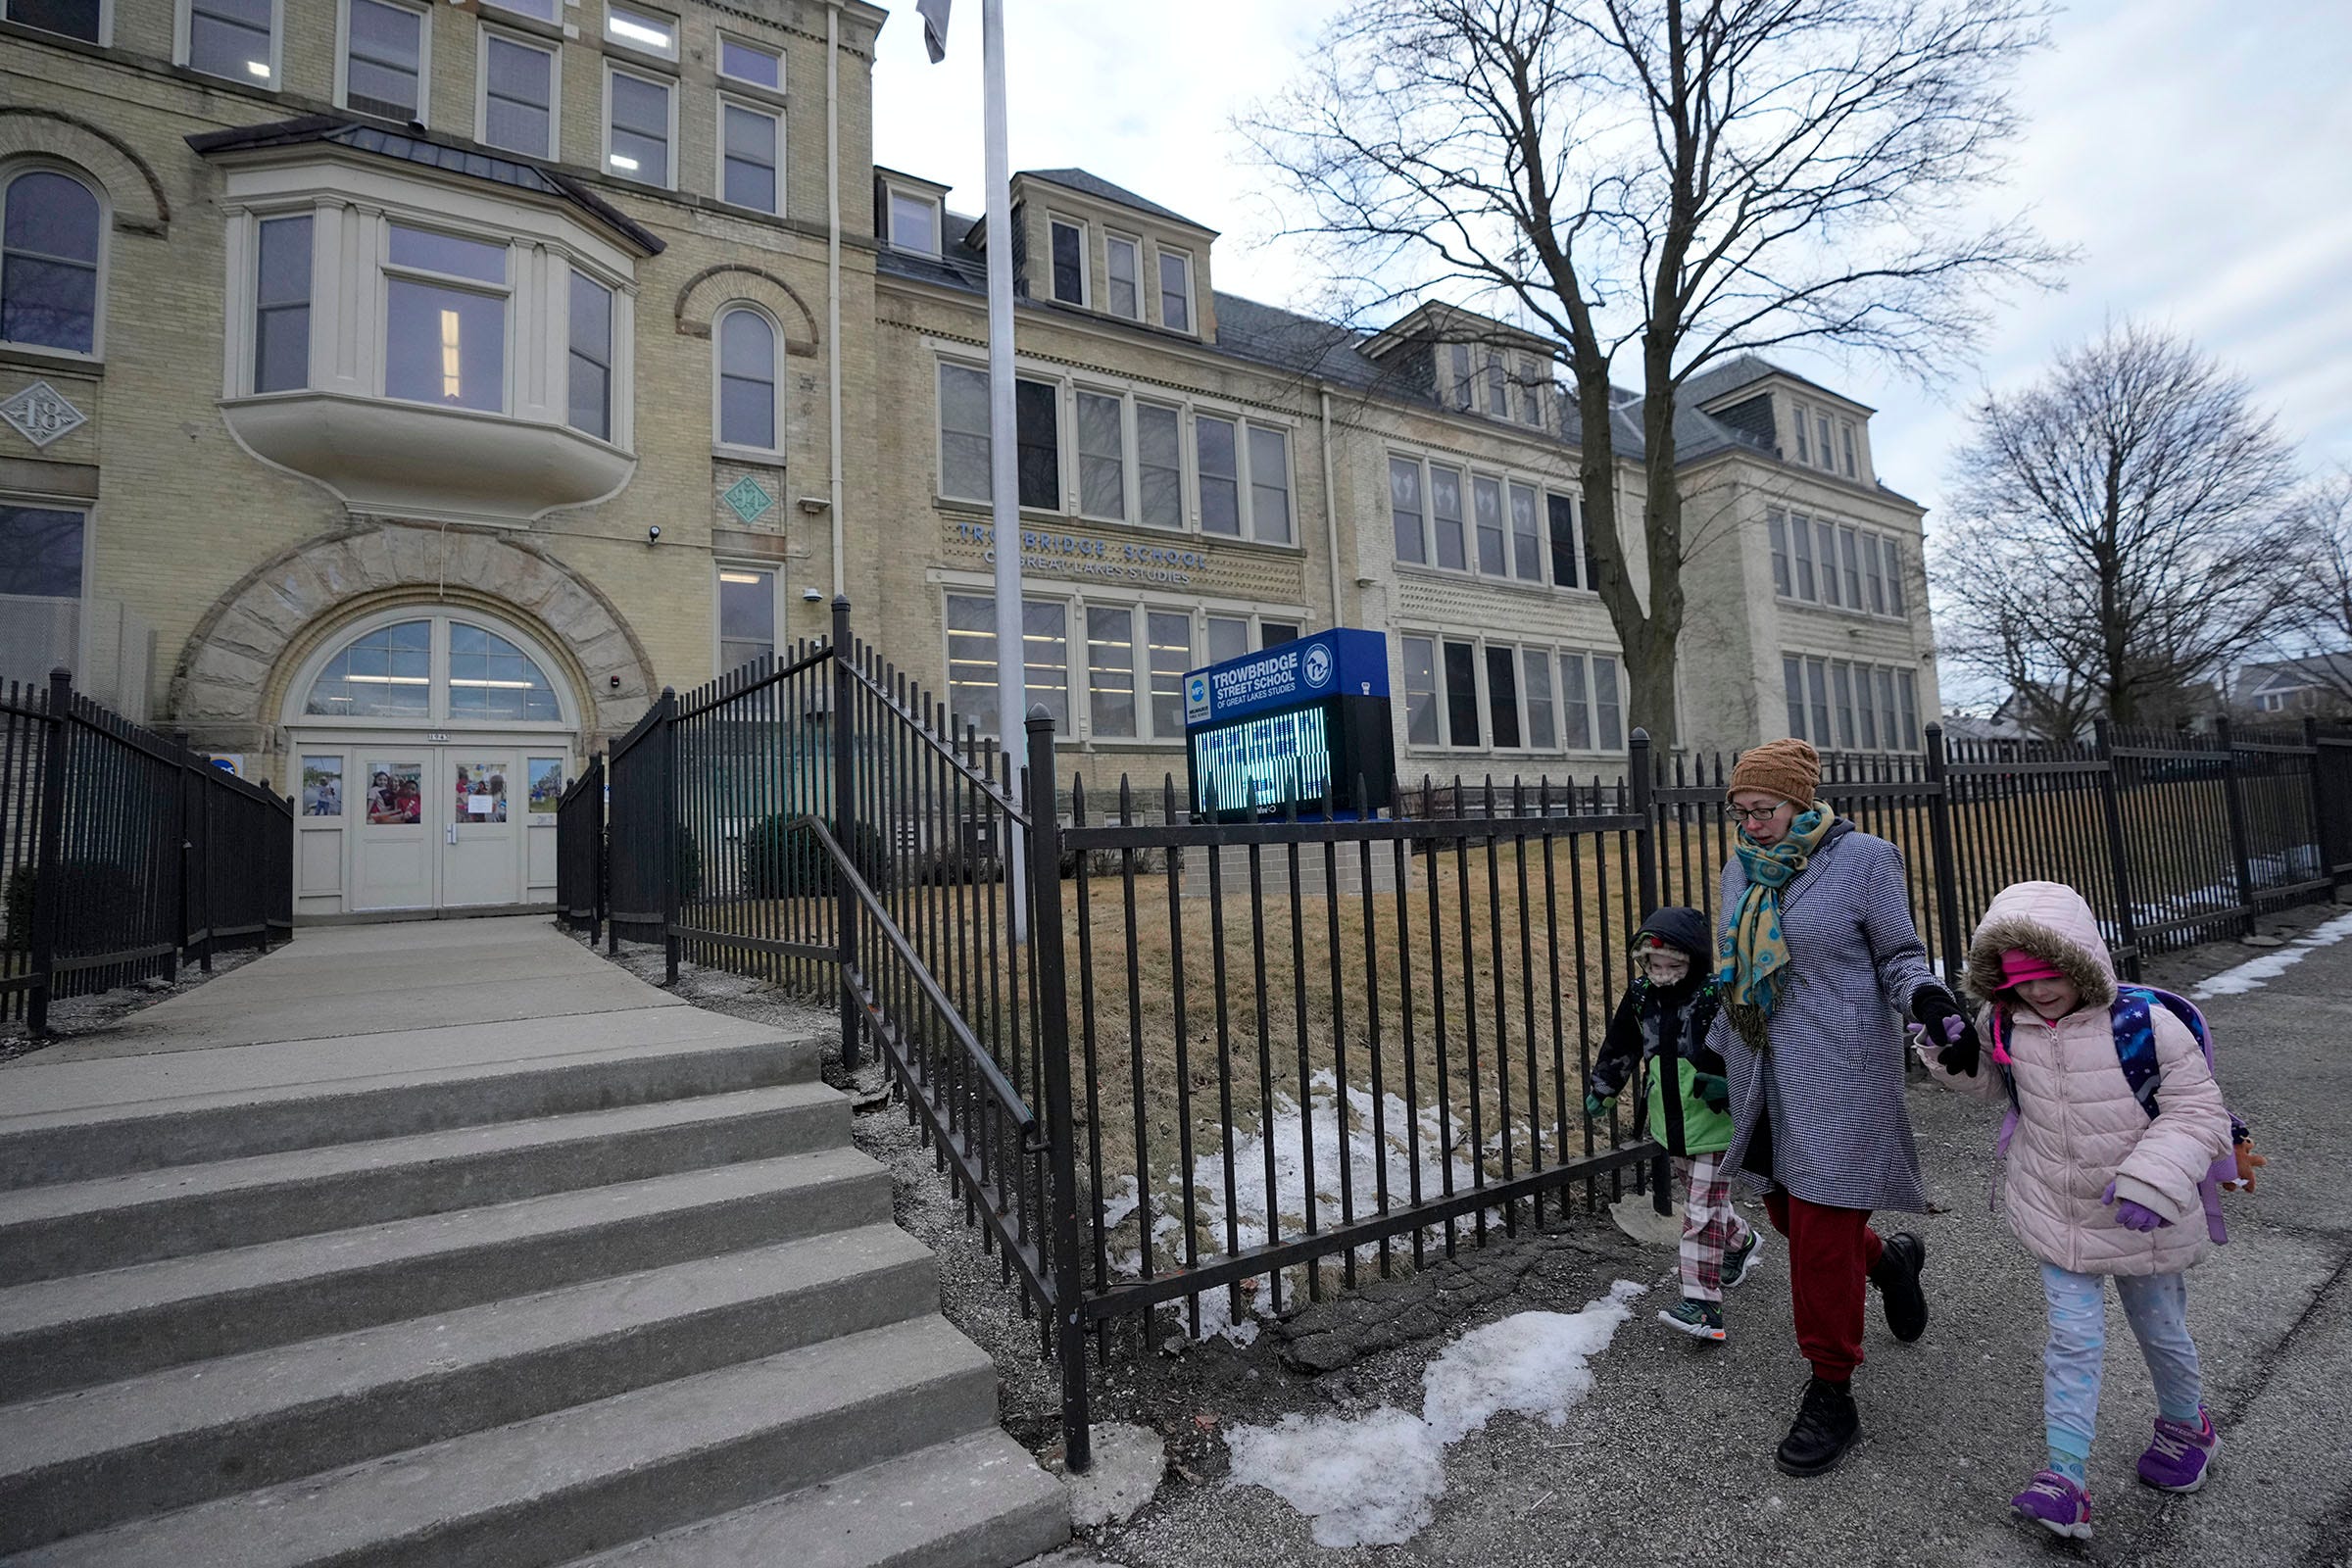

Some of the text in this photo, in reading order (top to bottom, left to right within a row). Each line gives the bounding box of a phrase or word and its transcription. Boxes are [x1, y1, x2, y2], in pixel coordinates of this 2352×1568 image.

[23, 399, 61, 429] 18
[959, 522, 1205, 568] TRBRIDGE SCHOOL
[1074, 562, 1123, 576] LAKES
[1128, 567, 1190, 584] STUDIES
[1212, 652, 1298, 689] TROWBRIDGE
[1217, 670, 1296, 700] STREET SCHOOL
[1217, 682, 1296, 709] OF GREAT LAKES STUDIES
